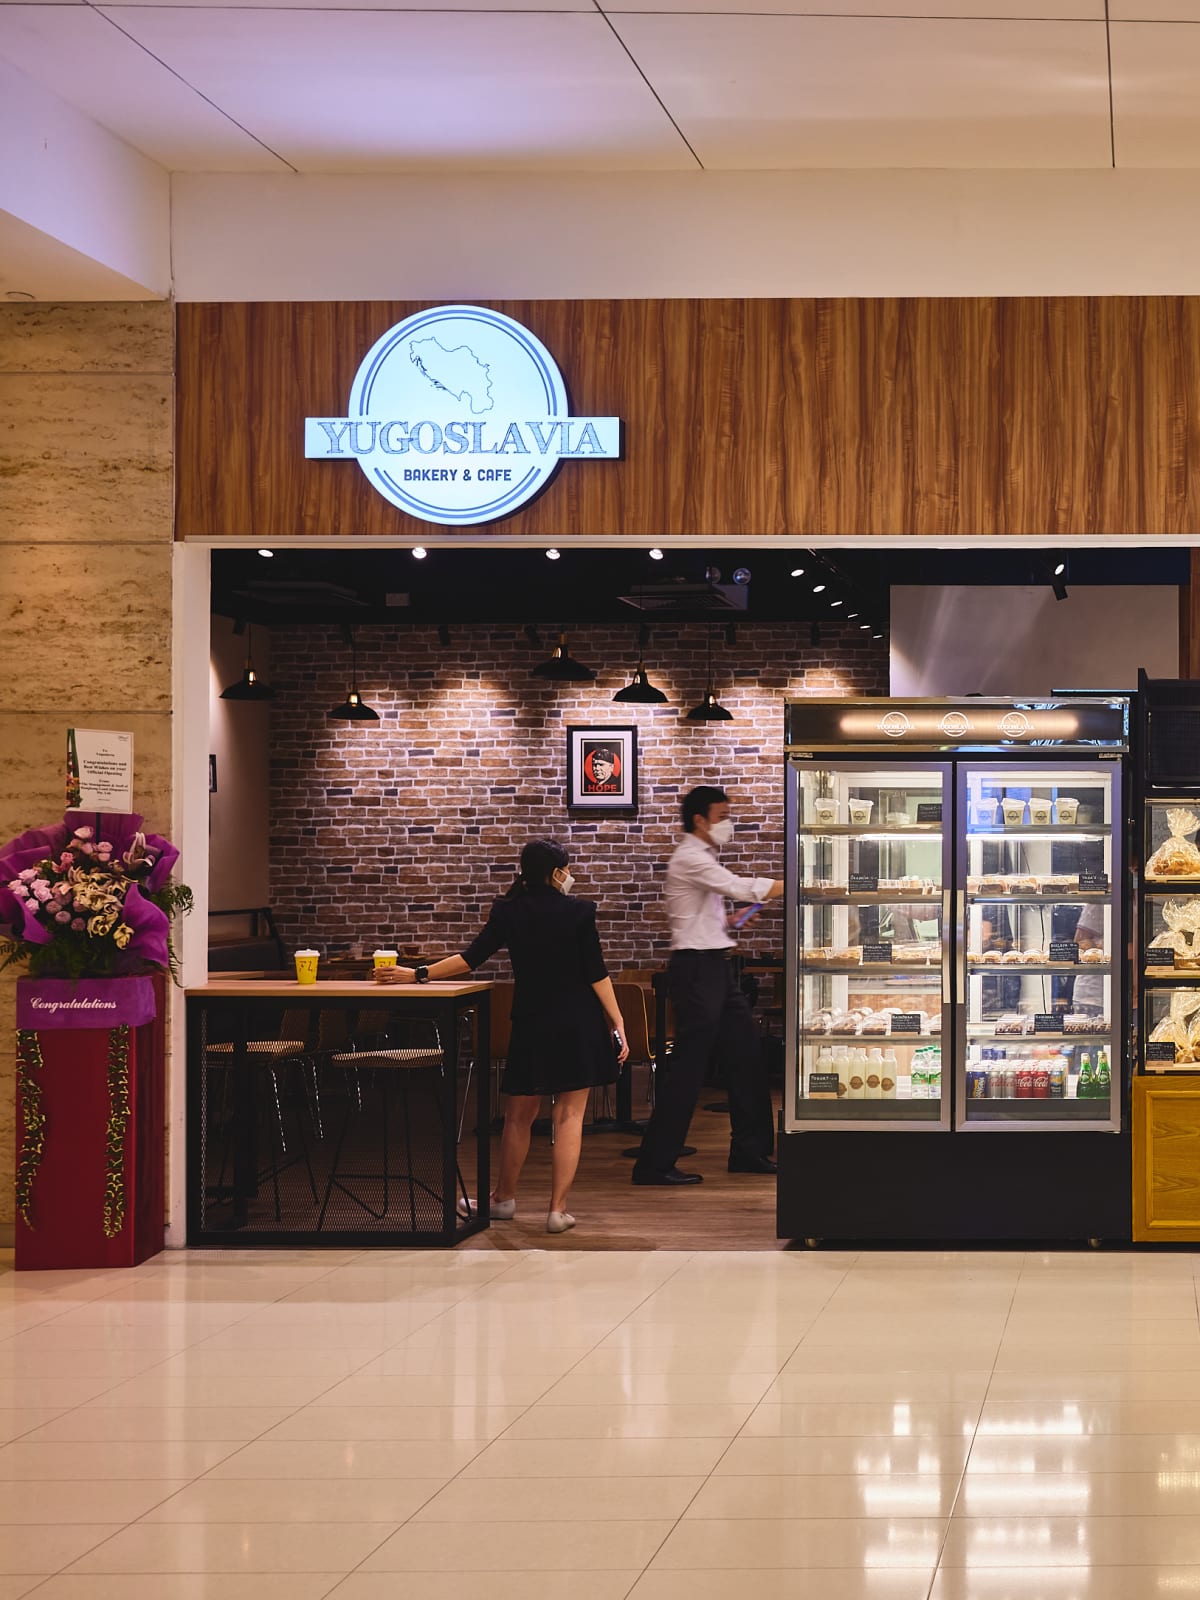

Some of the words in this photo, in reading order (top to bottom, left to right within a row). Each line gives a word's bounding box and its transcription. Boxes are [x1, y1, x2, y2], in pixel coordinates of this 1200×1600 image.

[318, 421, 607, 455] YUGOSLAVIA
[404, 469, 458, 481] BAKERY
[463, 469, 472, 481] &
[477, 469, 512, 481] CAFE
[30, 997, 116, 1014] Congratulations
